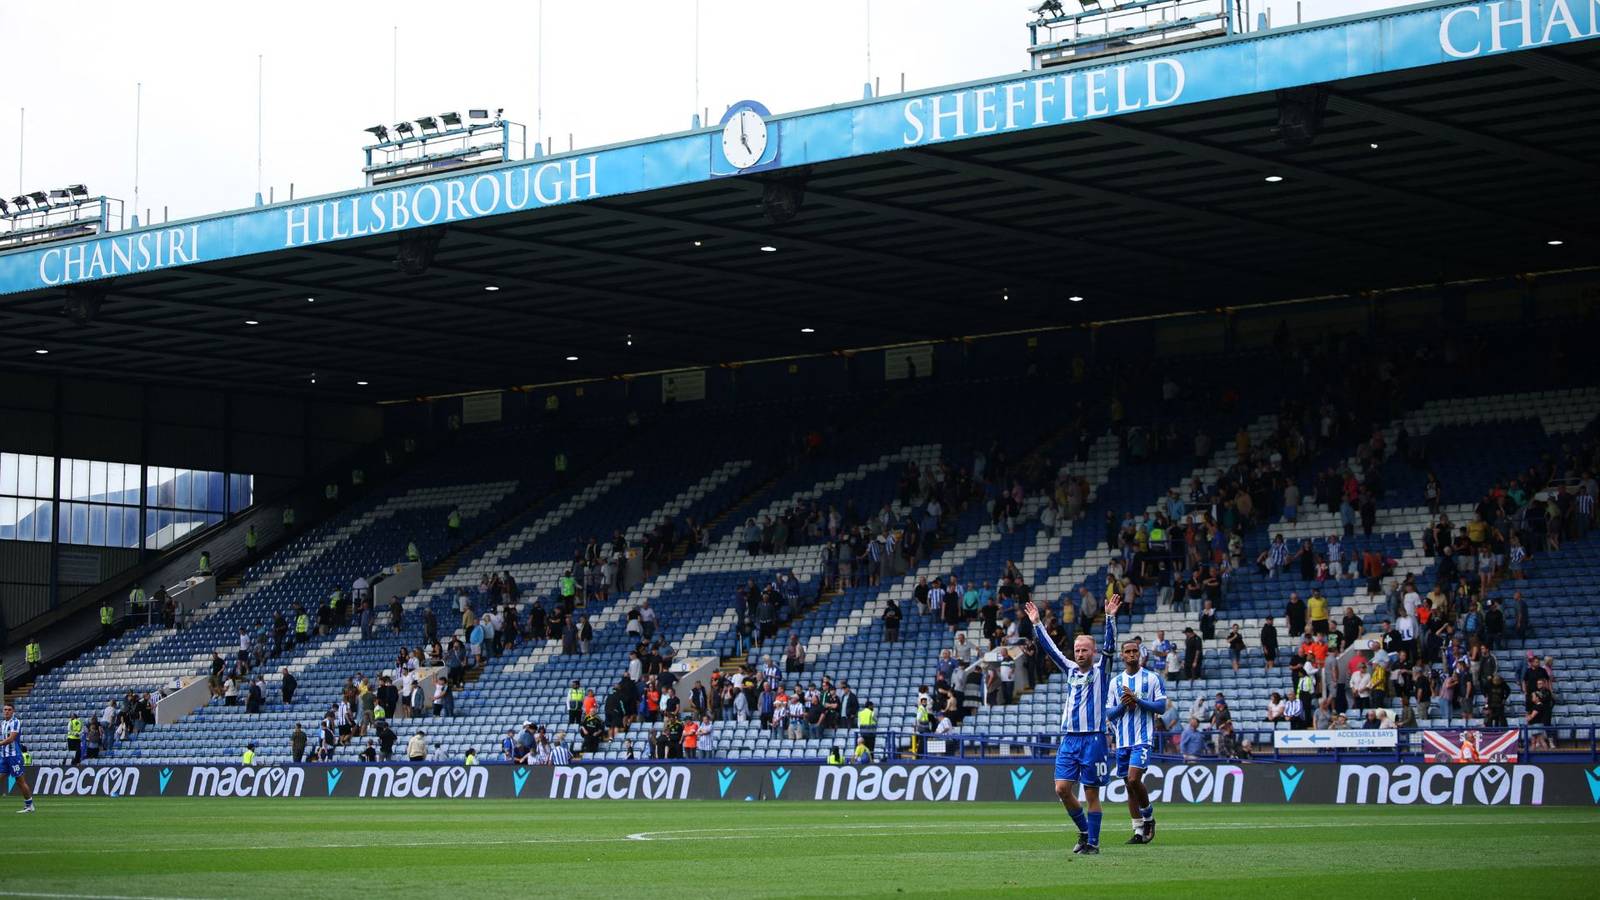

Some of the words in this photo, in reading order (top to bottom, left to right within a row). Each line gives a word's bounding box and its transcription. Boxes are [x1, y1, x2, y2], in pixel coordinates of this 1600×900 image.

[903, 58, 1186, 145] SHEFFIELD
[38, 226, 201, 286] CHANSIRI
[284, 155, 600, 249] HILLSBOROUGH
[34, 767, 139, 797] macron
[188, 767, 305, 797] macron
[359, 766, 489, 798] macron
[550, 766, 691, 799] macron
[814, 765, 979, 800] macron
[1077, 765, 1244, 803] acron
[1094, 762, 1108, 776] 10
[1336, 764, 1545, 805] macron
